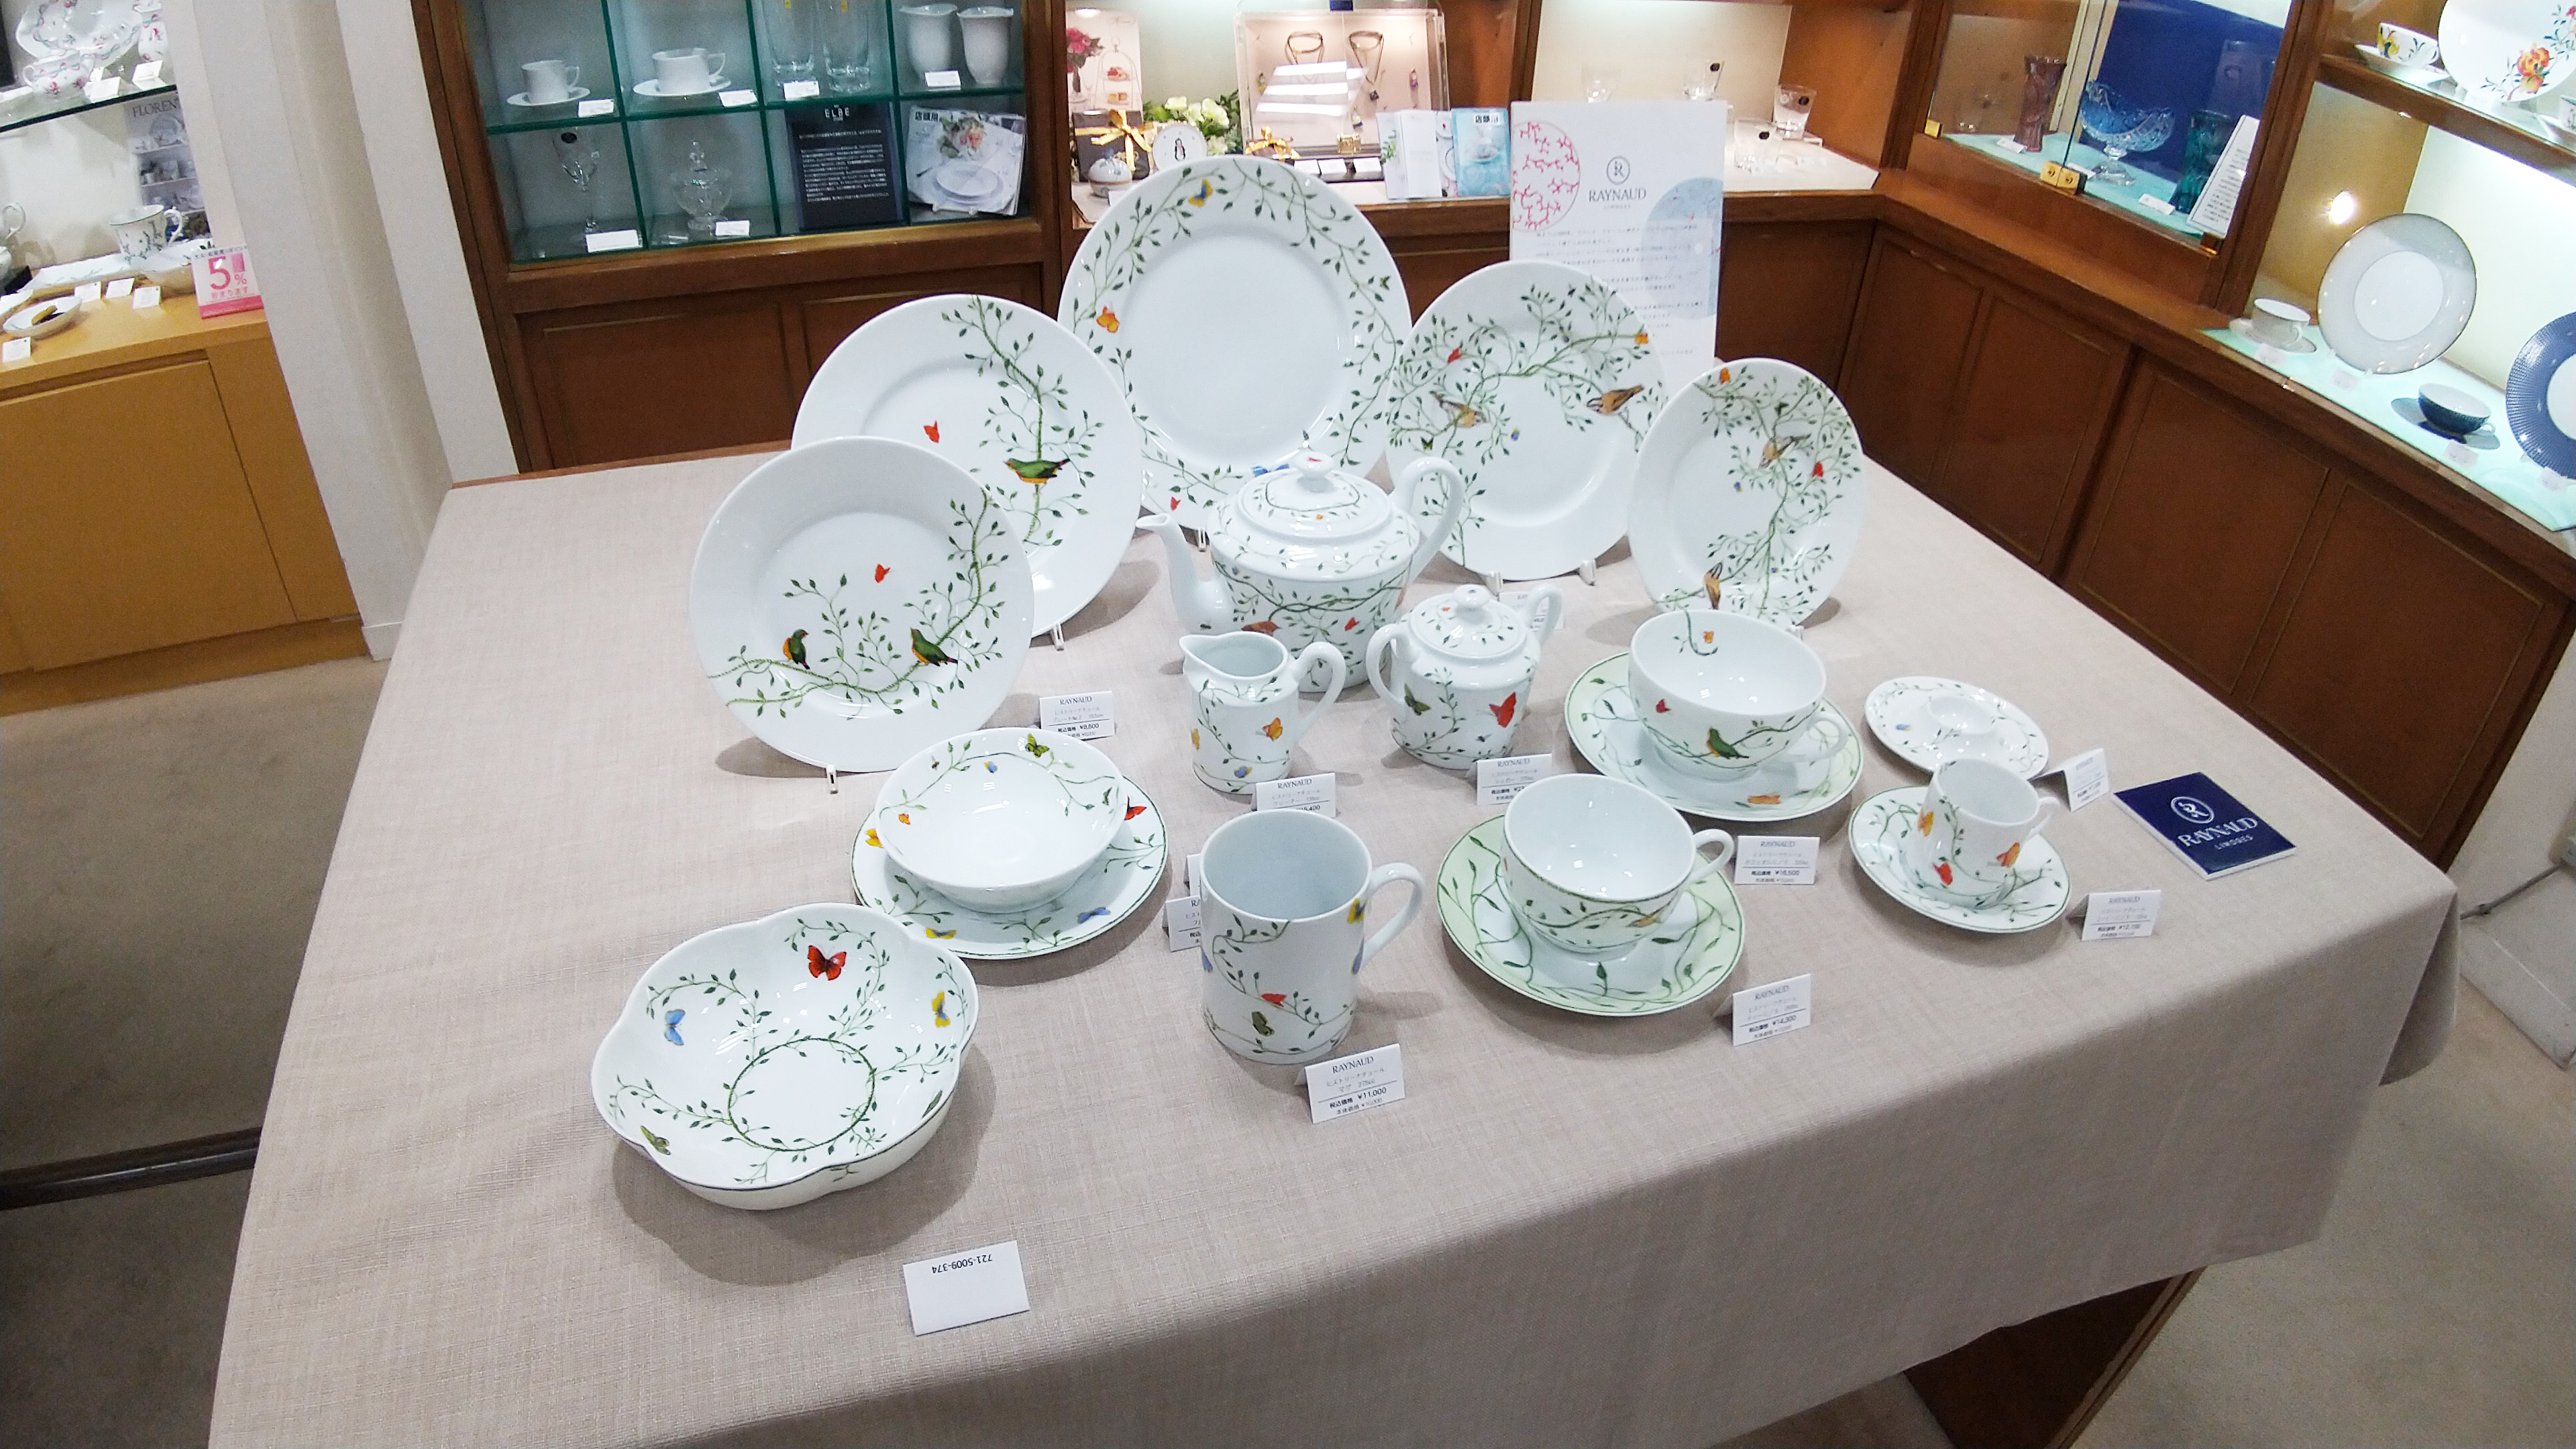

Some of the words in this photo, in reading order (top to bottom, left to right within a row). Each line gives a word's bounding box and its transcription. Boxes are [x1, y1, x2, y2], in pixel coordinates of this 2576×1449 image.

[824, 107, 850, 118] ELBE
[1589, 187, 1647, 203] RAYNAUD
[208, 256, 231, 290] 5
[1059, 696, 1093, 706] RAYNAUD
[1277, 778, 1312, 790] RAYNAUD
[2178, 816, 2259, 847] RAYNAUD
[1332, 1055, 1375, 1074] RAYNAUD
[1357, 1087, 1387, 1101] ¥11,000
[931, 1253, 993, 1275] 721-5009-374
